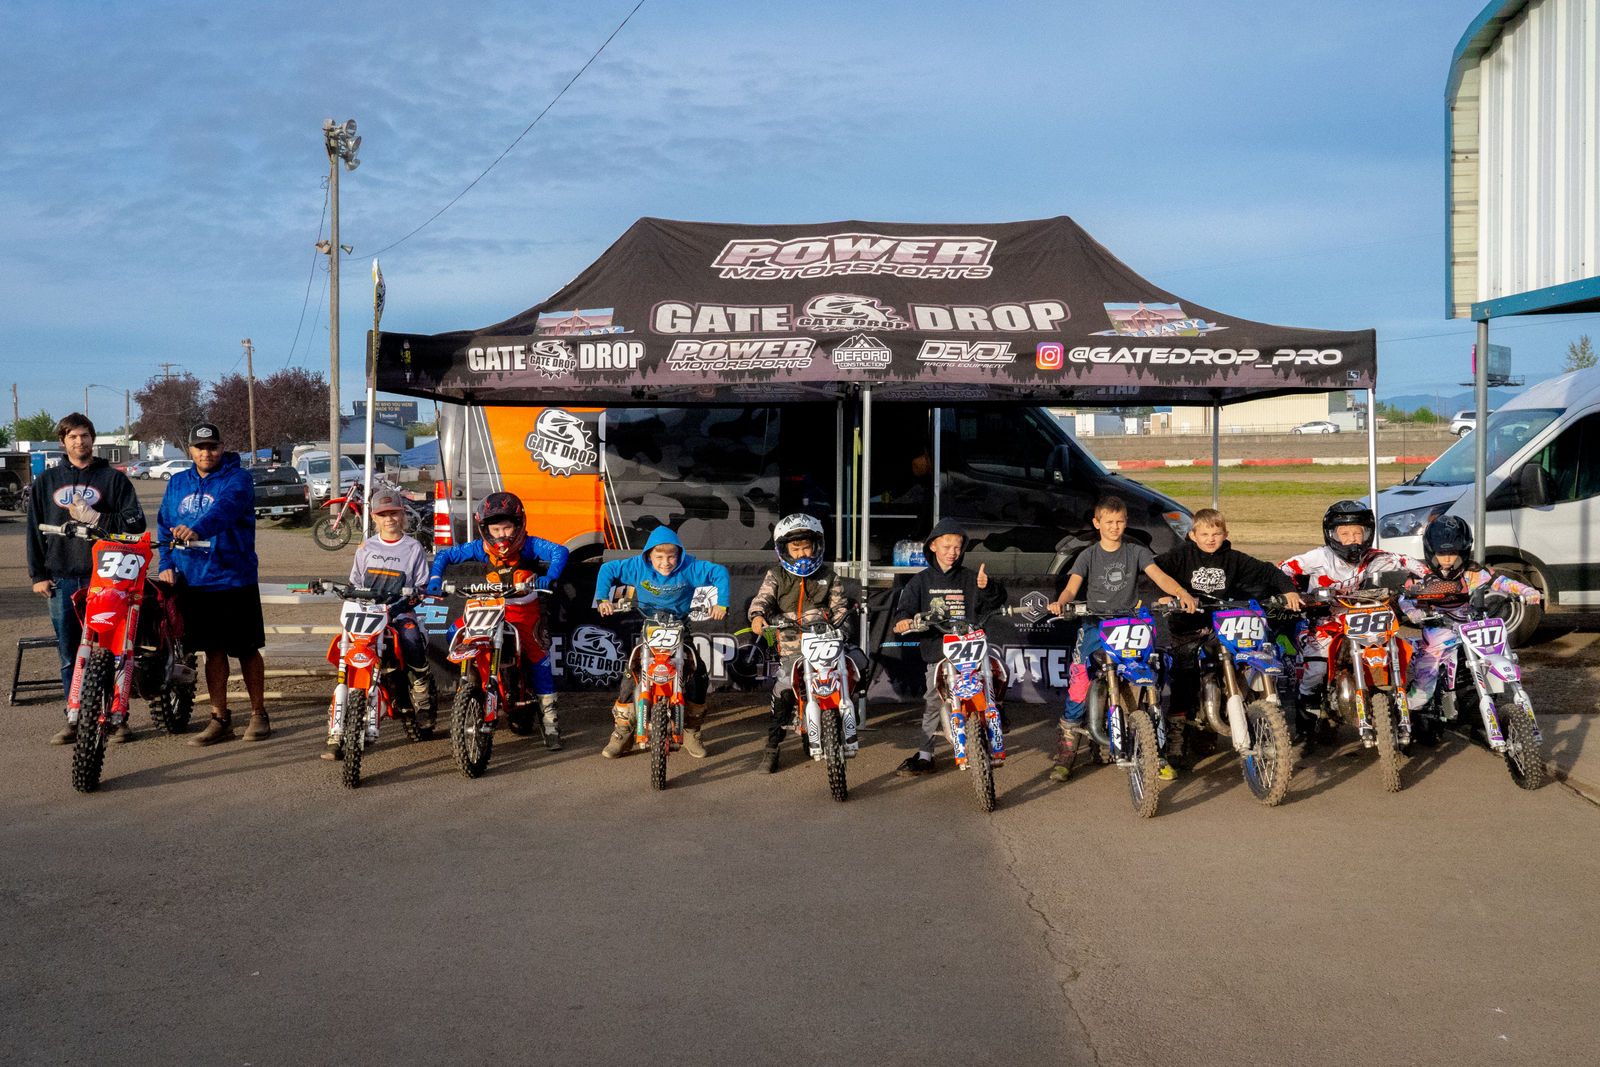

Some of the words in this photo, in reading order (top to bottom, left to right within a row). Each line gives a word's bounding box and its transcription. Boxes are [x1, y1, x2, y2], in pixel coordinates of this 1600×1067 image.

[716, 235, 992, 266] POWER
[719, 261, 993, 280] MOTORSPORTS
[656, 303, 791, 334] GATE
[799, 317, 847, 327] GATE
[852, 318, 909, 329] DROP
[914, 301, 1065, 331] DROP
[468, 345, 527, 371] GATE
[579, 342, 645, 369] DROP
[669, 340, 812, 361] POWER
[834, 350, 892, 362] DEFORD
[917, 341, 1016, 362] DEVOL
[1069, 346, 1343, 368] @GATEDROP_PRO
[529, 355, 551, 367] GATE
[552, 357, 576, 370] DROP
[671, 358, 813, 371] MOTORSPORTS
[527, 435, 559, 455] GATE
[560, 444, 597, 466] DROP
[96, 551, 146, 580] 38
[344, 612, 384, 634] 117
[1218, 616, 1267, 641] 449
[1347, 612, 1394, 635] 98
[648, 629, 680, 647] 25
[1105, 624, 1153, 650] 49
[1466, 626, 1503, 647] 317
[567, 652, 595, 668] GATE
[809, 640, 840, 662] 76
[948, 641, 985, 664] 247
[1005, 648, 1069, 688] ATE
